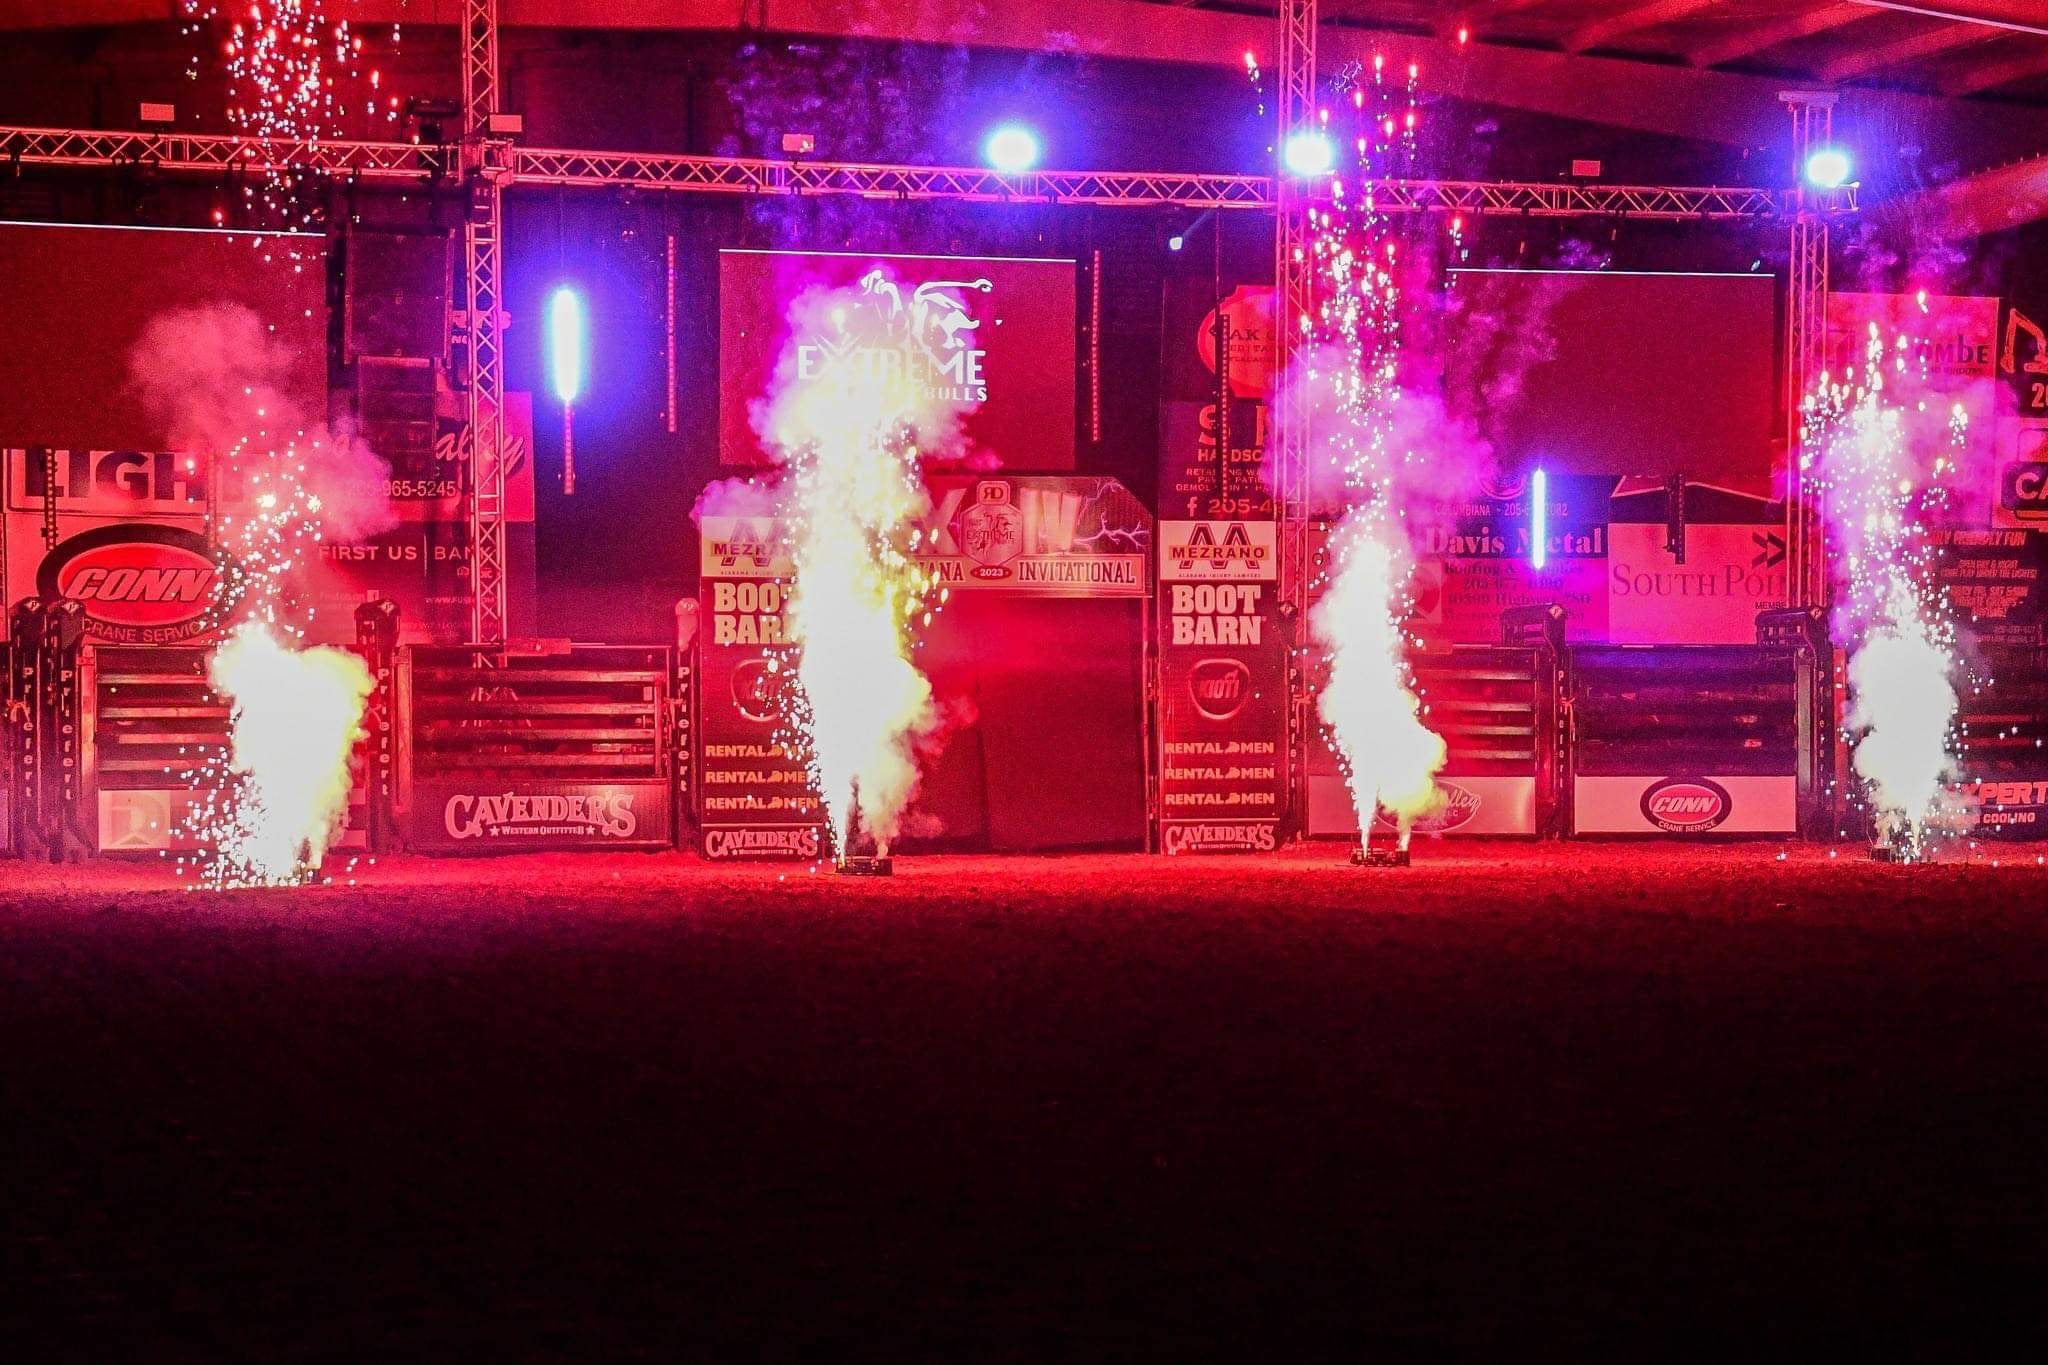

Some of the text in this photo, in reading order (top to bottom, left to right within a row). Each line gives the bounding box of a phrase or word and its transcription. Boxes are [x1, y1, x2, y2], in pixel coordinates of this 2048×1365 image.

[319, 546, 379, 561] FIRST
[388, 546, 418, 561] US
[1171, 547, 1265, 559] MEZRANO
[979, 566, 1005, 578] 2023
[1018, 561, 1136, 584] INVITATIONAL
[64, 567, 218, 601] CONN
[1171, 584, 1262, 614] BOOT
[1172, 615, 1262, 645] BARN
[705, 744, 766, 758] RENTAL
[1164, 742, 1275, 755] RENTAL MEN
[705, 770, 766, 784] RENTAL
[1164, 767, 1275, 780] RENTAL MEN
[705, 797, 818, 810] RENTAL MEN
[1164, 793, 1275, 805] RENTAL MEN
[1652, 796, 1718, 813] CONN
[444, 790, 637, 840] CAVENDER'S
[705, 829, 818, 857] CAVENDER'S
[1165, 823, 1275, 851] CAVENDER'S
